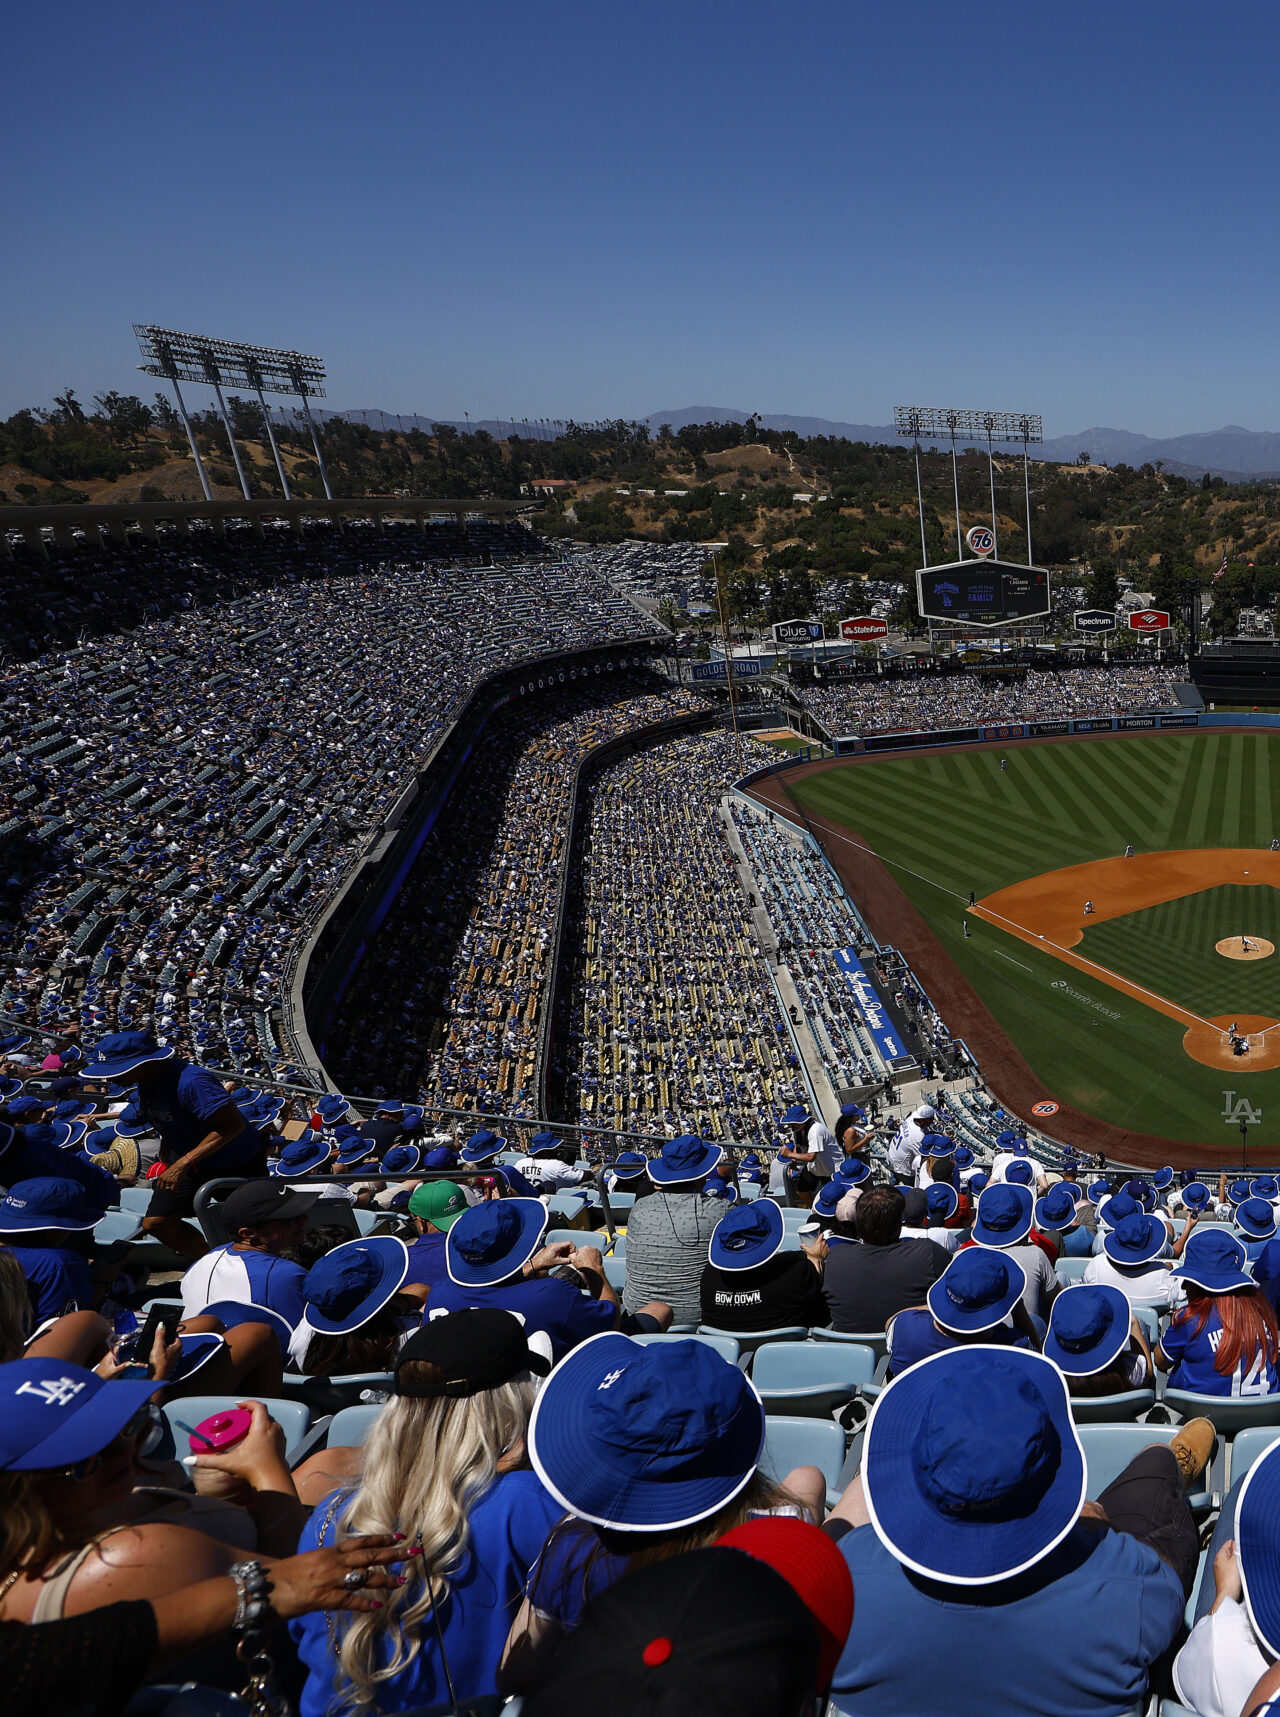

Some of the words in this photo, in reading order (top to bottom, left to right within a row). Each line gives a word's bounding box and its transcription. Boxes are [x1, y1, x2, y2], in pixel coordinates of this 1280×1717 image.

[972, 532, 993, 549] 76
[1078, 617, 1111, 626] Spectrum
[779, 625, 807, 637] blue
[734, 663, 757, 673] ROAD
[1126, 719, 1153, 727] MORTON
[1035, 1103, 1055, 1114] 76
[1220, 1090, 1262, 1124] LA
[521, 1166, 542, 1176] BETTS
[715, 1292, 733, 1303] BOW
[734, 1291, 760, 1304] DOWN
[15, 1375, 87, 1406] LA
